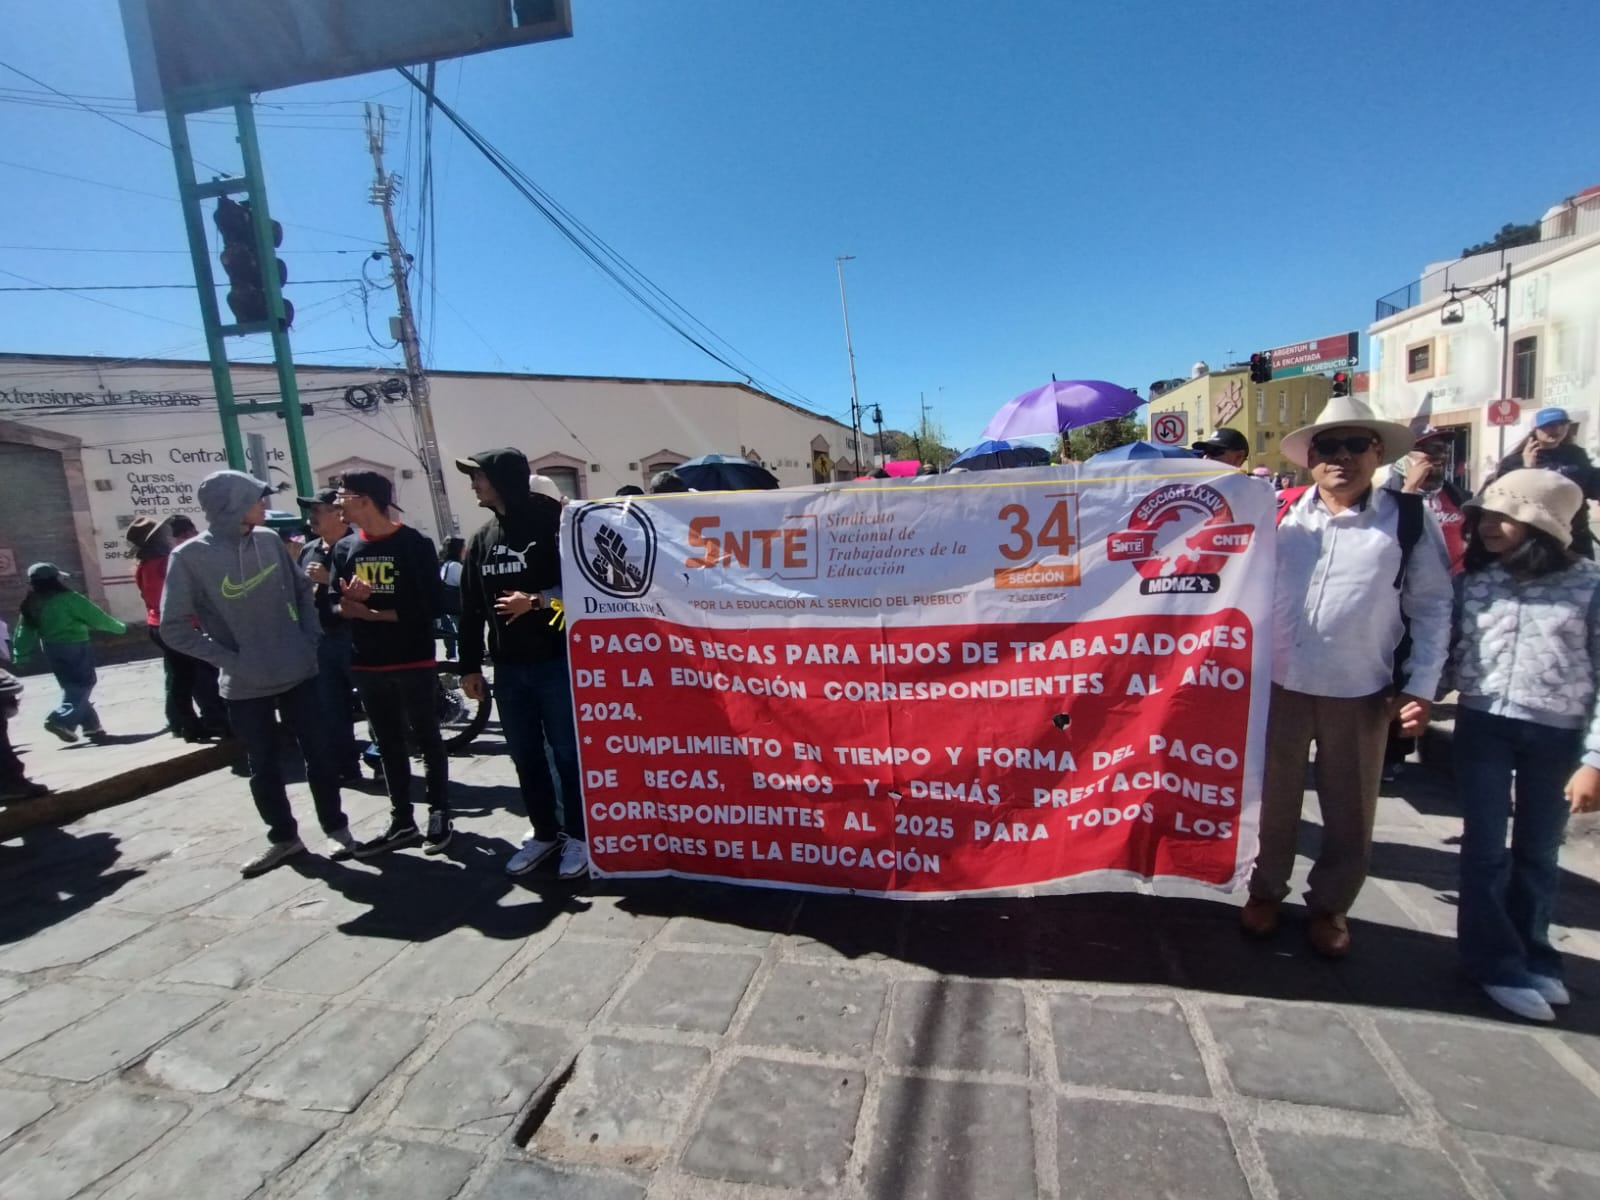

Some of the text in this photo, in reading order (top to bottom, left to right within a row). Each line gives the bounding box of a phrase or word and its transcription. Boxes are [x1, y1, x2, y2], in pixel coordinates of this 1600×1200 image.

[1273, 344, 1307, 357] ARGENTUM
[1273, 353, 1320, 368] LA ENCANTADA
[1305, 359, 1346, 372] ACUEDUCTO
[108, 449, 153, 465] Lash
[170, 449, 227, 463] Central
[127, 472, 175, 483] Cursos
[131, 482, 192, 496] Aplicación
[131, 493, 192, 506] Venta de
[1137, 486, 1224, 521] SECCIÓN XXXIV
[826, 511, 895, 528] Sindicato
[828, 526, 915, 544] Nacional de
[998, 500, 1075, 560] 34
[685, 516, 807, 568] SNTE
[1212, 534, 1249, 546] CNTE
[828, 541, 967, 562] Trabajadores de la
[355, 562, 394, 586] NYC
[826, 562, 905, 578] Educación
[1149, 577, 1196, 593] MDMZ
[720, 600, 733, 610] LA
[737, 598, 806, 609] EDUCACIÓN
[809, 599, 824, 608] AL
[828, 597, 882, 608] SERVICIO
[886, 596, 908, 607] DEL
[1008, 592, 1067, 603] ZACATECAS
[590, 625, 1247, 665] PAGO DE BECAS PARA HIJOS DE TRABAJADORES
[576, 659, 1245, 702] DE LA EDUCACIÓN CORRESPONDIENTES AL AÑO
[579, 702, 643, 722] 2024.
[605, 735, 1238, 772] CUMPLIMIENTO EN TIEMPO Y FORMA DEL PAGO
[586, 769, 1236, 808] DE BECAS, BONOS Y DEMÁS PRESTACIONES
[590, 801, 1233, 842] CORRESPONDIENTES AL 2025 PARA TODOS LOS
[593, 832, 940, 874] SECTORES DE LA EDUCACIÓN
